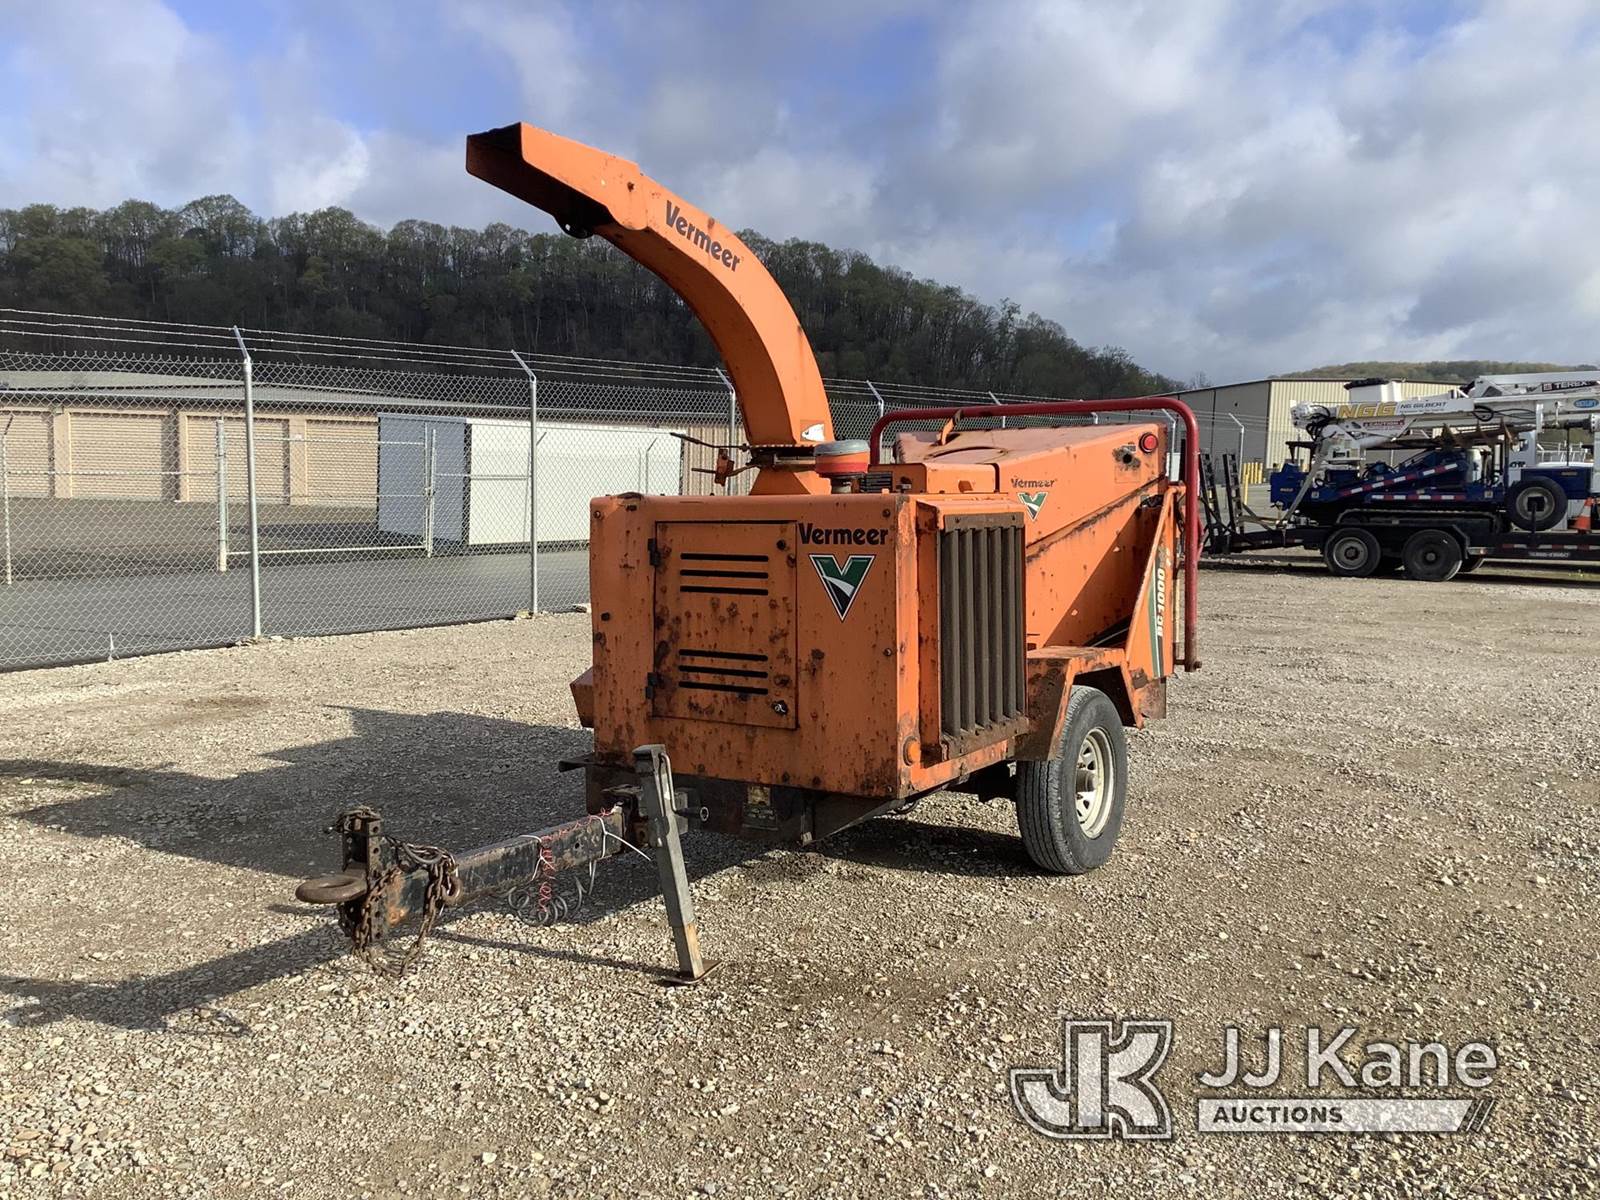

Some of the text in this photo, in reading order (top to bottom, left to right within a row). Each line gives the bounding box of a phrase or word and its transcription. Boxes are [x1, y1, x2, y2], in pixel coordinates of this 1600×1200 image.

[665, 199, 740, 272] Vermeer
[1555, 381, 1588, 389] TEREX
[1338, 401, 1398, 419] NGG
[1011, 478, 1055, 488] Vermeer
[798, 522, 889, 545] Vermeer
[1157, 567, 1166, 613] 1000
